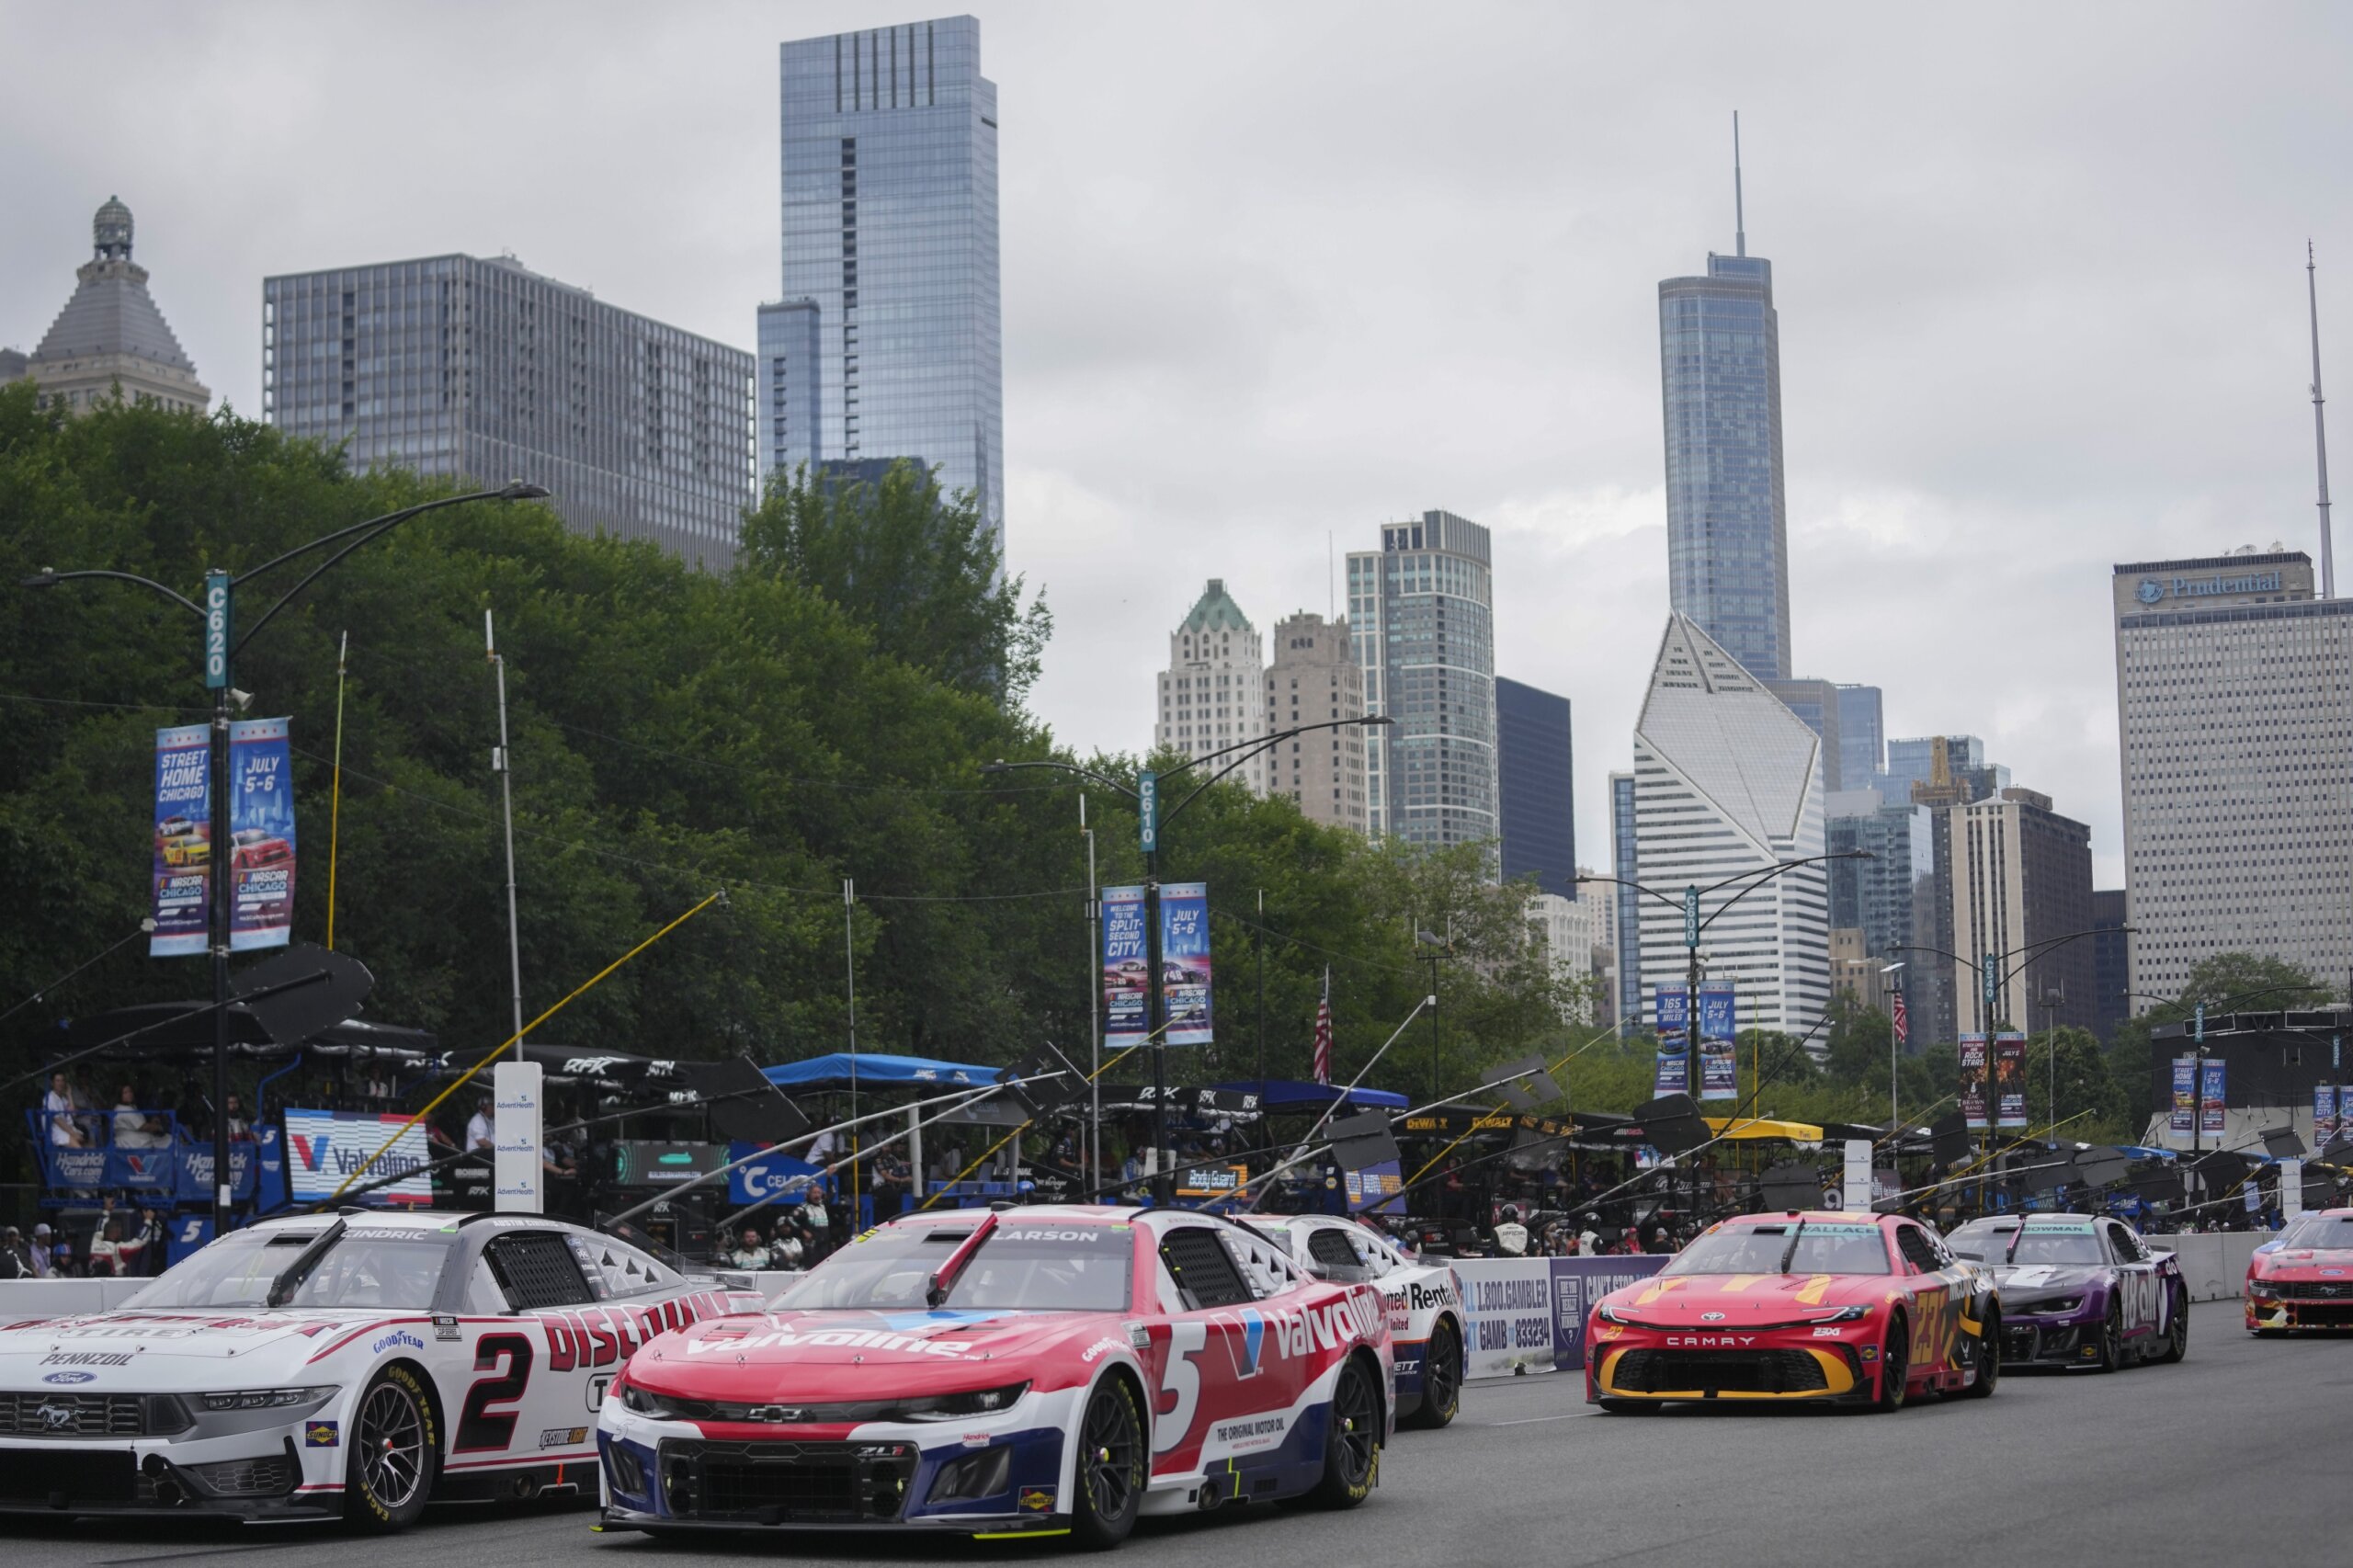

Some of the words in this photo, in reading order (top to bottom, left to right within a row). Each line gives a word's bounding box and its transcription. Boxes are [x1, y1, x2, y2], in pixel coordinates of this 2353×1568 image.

[2173, 571, 2281, 597] Prudential
[208, 586, 226, 676] C620
[161, 750, 207, 768] STREET
[246, 756, 279, 774] JULY
[161, 765, 206, 788] HOME
[244, 775, 275, 793] 5-6
[159, 786, 204, 801] CHICAGO
[1140, 780, 1154, 844] C610
[170, 875, 203, 887] NASCAR
[250, 869, 289, 882] NASCAR
[160, 887, 202, 898] CHICAGO
[238, 881, 287, 893] CHICAGO
[1110, 903, 1138, 912] WELCOME
[1173, 910, 1199, 922] JULY
[1687, 895, 1697, 941] C600
[1109, 919, 1142, 931] SPLIT-
[1172, 923, 1196, 935] 5-6
[1108, 931, 1140, 941] SECOND
[1108, 940, 1141, 957] CITY
[1986, 960, 1995, 997] C540
[1170, 996, 1206, 1005] CHICAGO
[1664, 998, 1681, 1008] 165
[1708, 1001, 1729, 1009] JULY
[1663, 1014, 1683, 1022] MILES
[1707, 1010, 1726, 1019] 5-6
[563, 1057, 613, 1074] RFK
[1138, 1086, 1181, 1099] RK
[1406, 1118, 1449, 1130] DEWAT
[262, 1131, 276, 1143] 5
[56, 1153, 107, 1171] Hendrick
[187, 1153, 247, 1171] Henick
[63, 1166, 103, 1177] Cars.com
[1326, 1166, 1335, 1175] 9
[1188, 1169, 1211, 1192] Body
[181, 1221, 203, 1242] 5
[341, 1230, 428, 1240] CINDRIC
[991, 1231, 1098, 1242] LARSON
[1477, 1278, 1548, 1312] 1.800.GAMBLER
[1560, 1281, 1569, 1295] ARE
[1569, 1281, 1577, 1294] YOU
[1586, 1276, 1611, 1305] CAN'T
[2122, 1271, 2138, 1330] 48
[2139, 1264, 2168, 1335] ally
[1264, 1287, 1381, 1360] Valvoline
[1910, 1291, 1940, 1365] 23
[1480, 1320, 1507, 1351] GAMB
[1516, 1317, 1550, 1349] 833234
[1568, 1329, 1573, 1344] ?
[1601, 1325, 1624, 1340] 23
[373, 1330, 424, 1354] GOODYEAR
[1666, 1336, 1756, 1346] CAMRY
[39, 1353, 135, 1366] PENNZOIL
[49, 1372, 90, 1383] Ford
[452, 1332, 534, 1455] 2
[1153, 1322, 1207, 1454] 5
[308, 1429, 336, 1440] SUNOCO
[1218, 1426, 1228, 1442] THE
[1228, 1422, 1255, 1440] ORIGINAL
[1255, 1419, 1275, 1436] MOTOR
[1276, 1417, 1284, 1431] OIL
[540, 1429, 570, 1450] KEYSTONE
[962, 1433, 991, 1442] Hendrick
